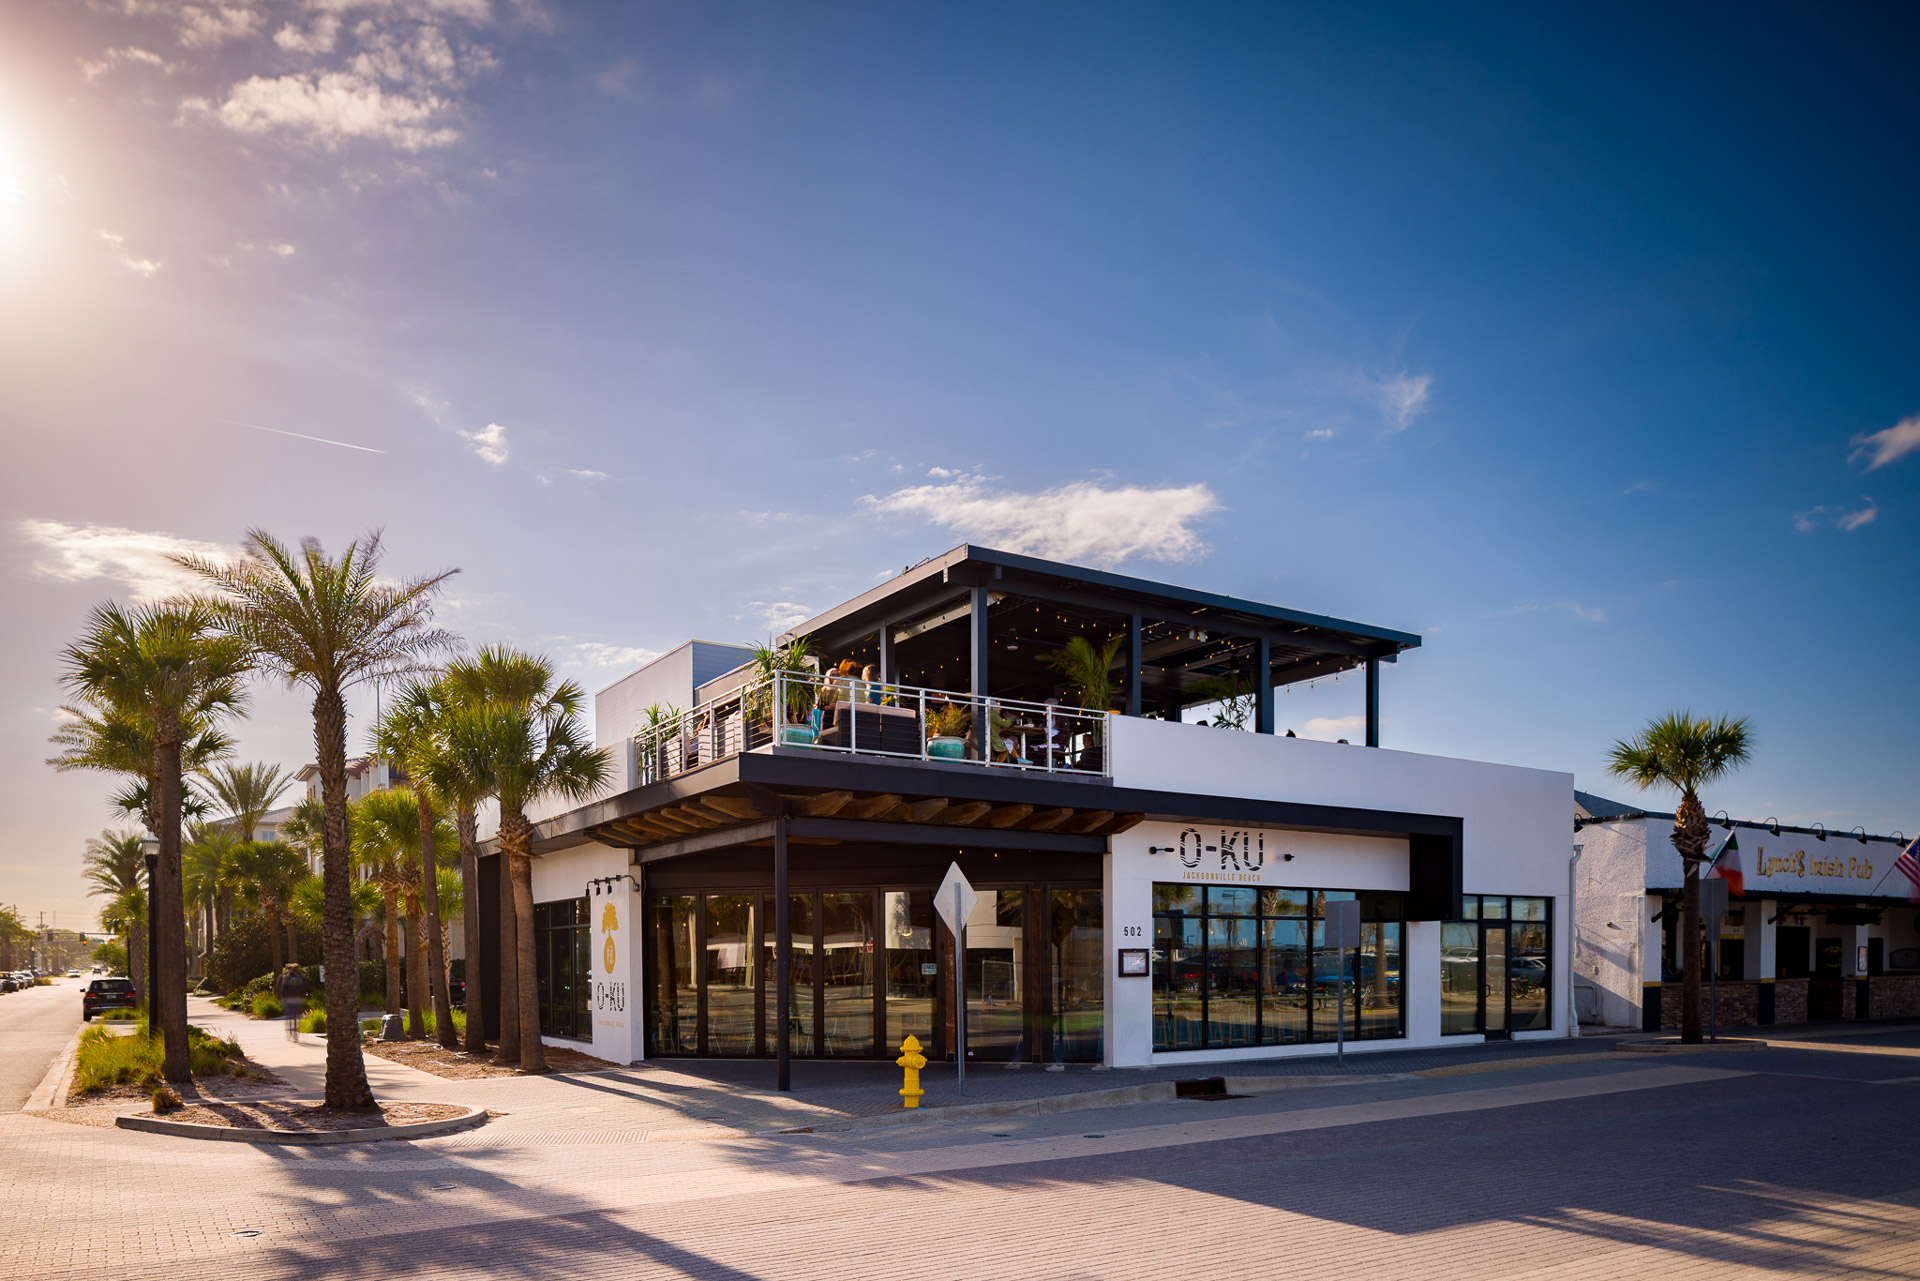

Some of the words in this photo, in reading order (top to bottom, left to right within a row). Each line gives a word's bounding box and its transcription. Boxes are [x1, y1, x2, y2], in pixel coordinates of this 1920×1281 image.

[1180, 828, 1263, 871] O-KU
[1182, 871, 1235, 881] JACKSONVILLE
[1239, 874, 1261, 882] BEACH
[1809, 854, 1844, 878] Irish
[1849, 857, 1873, 880] Pub
[1124, 926, 1142, 937] 502
[597, 982, 625, 1012] O-KU
